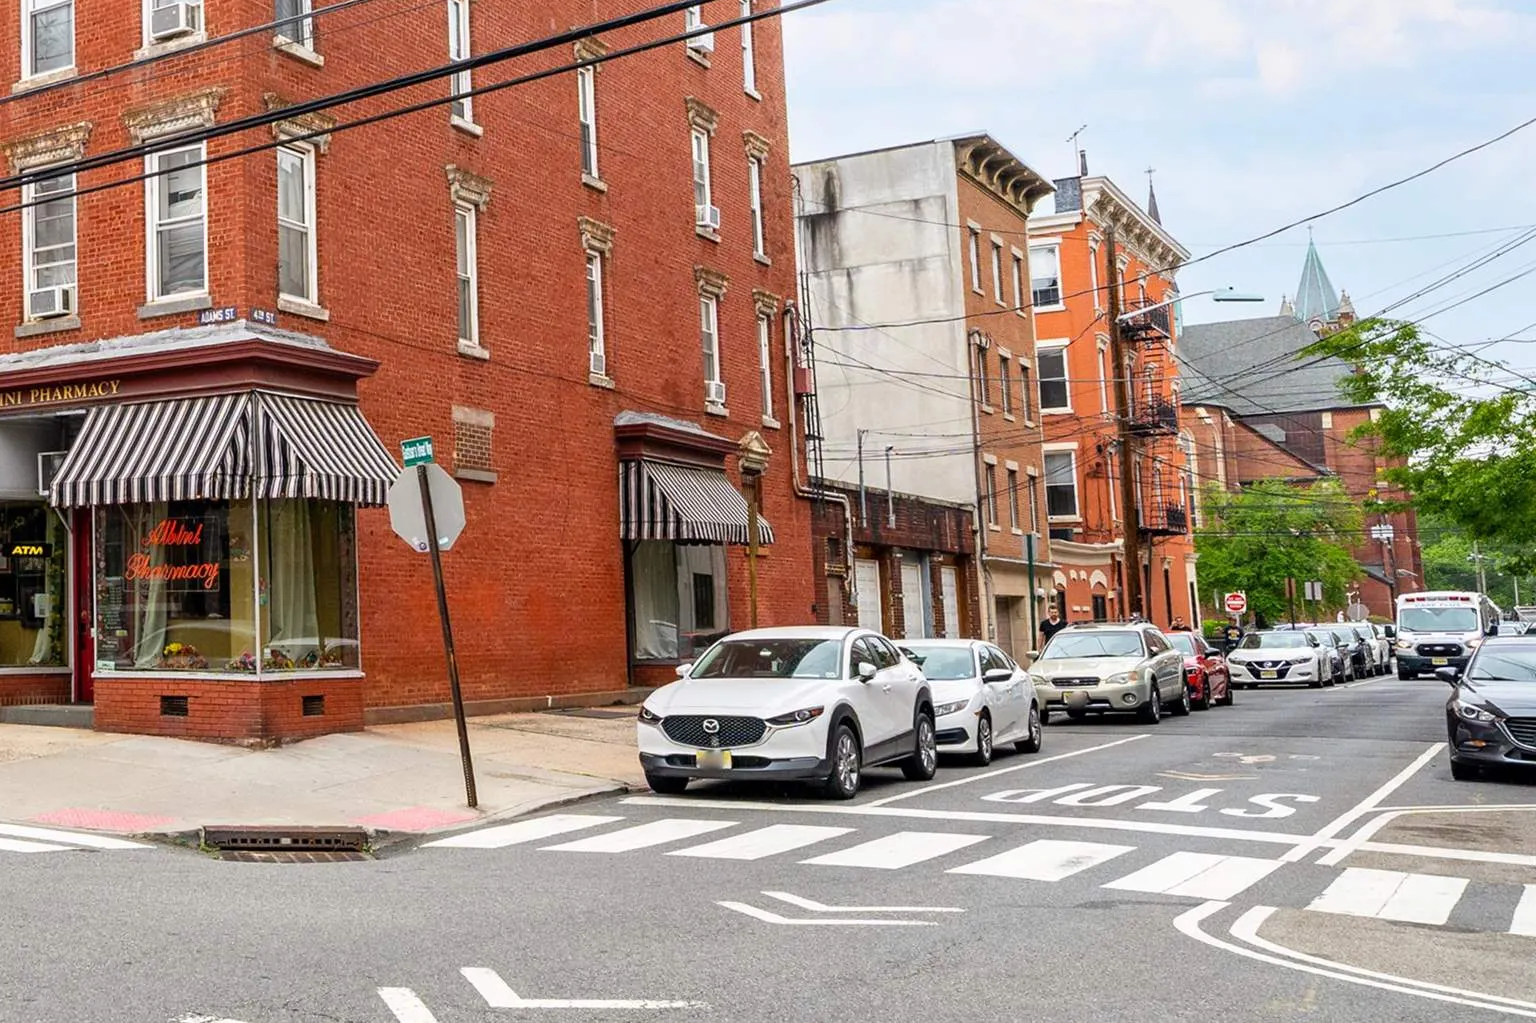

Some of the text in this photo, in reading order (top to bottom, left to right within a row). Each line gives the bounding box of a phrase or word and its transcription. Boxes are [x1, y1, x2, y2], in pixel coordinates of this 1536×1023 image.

[200, 311, 223, 324] ADAMS
[30, 379, 120, 403] PHARMACY
[12, 545, 43, 555] ATM
[125, 552, 219, 589] Pharmacy
[979, 783, 1321, 819] STOP
